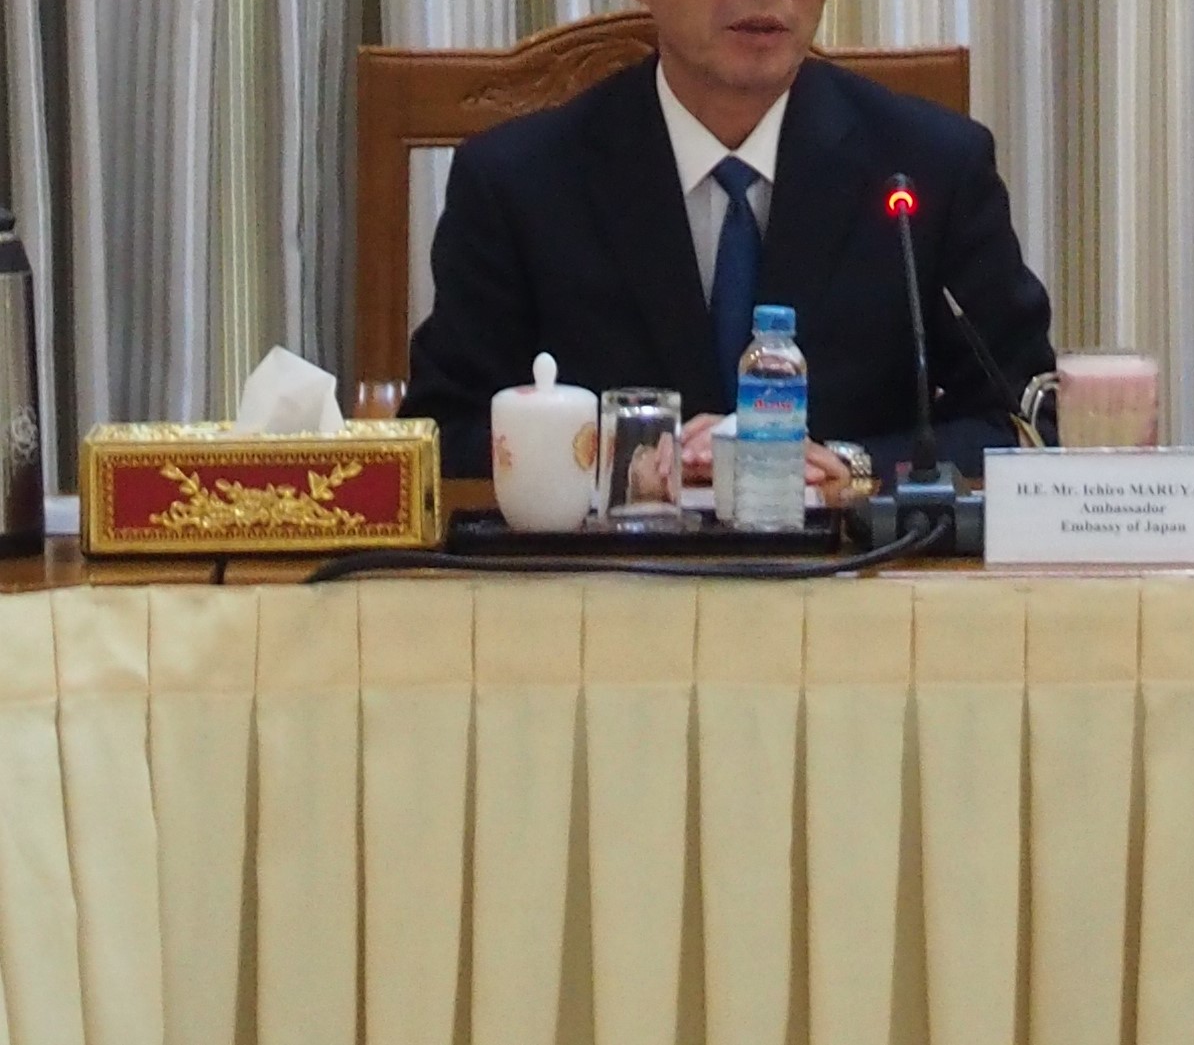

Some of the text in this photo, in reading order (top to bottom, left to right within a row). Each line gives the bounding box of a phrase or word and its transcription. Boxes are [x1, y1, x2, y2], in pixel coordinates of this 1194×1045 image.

[1053, 482, 1078, 496] Mr.
[1083, 482, 1125, 496] Ichiro
[1081, 502, 1167, 514] Ambassador
[1061, 520, 1187, 535] Embassy of Japan
